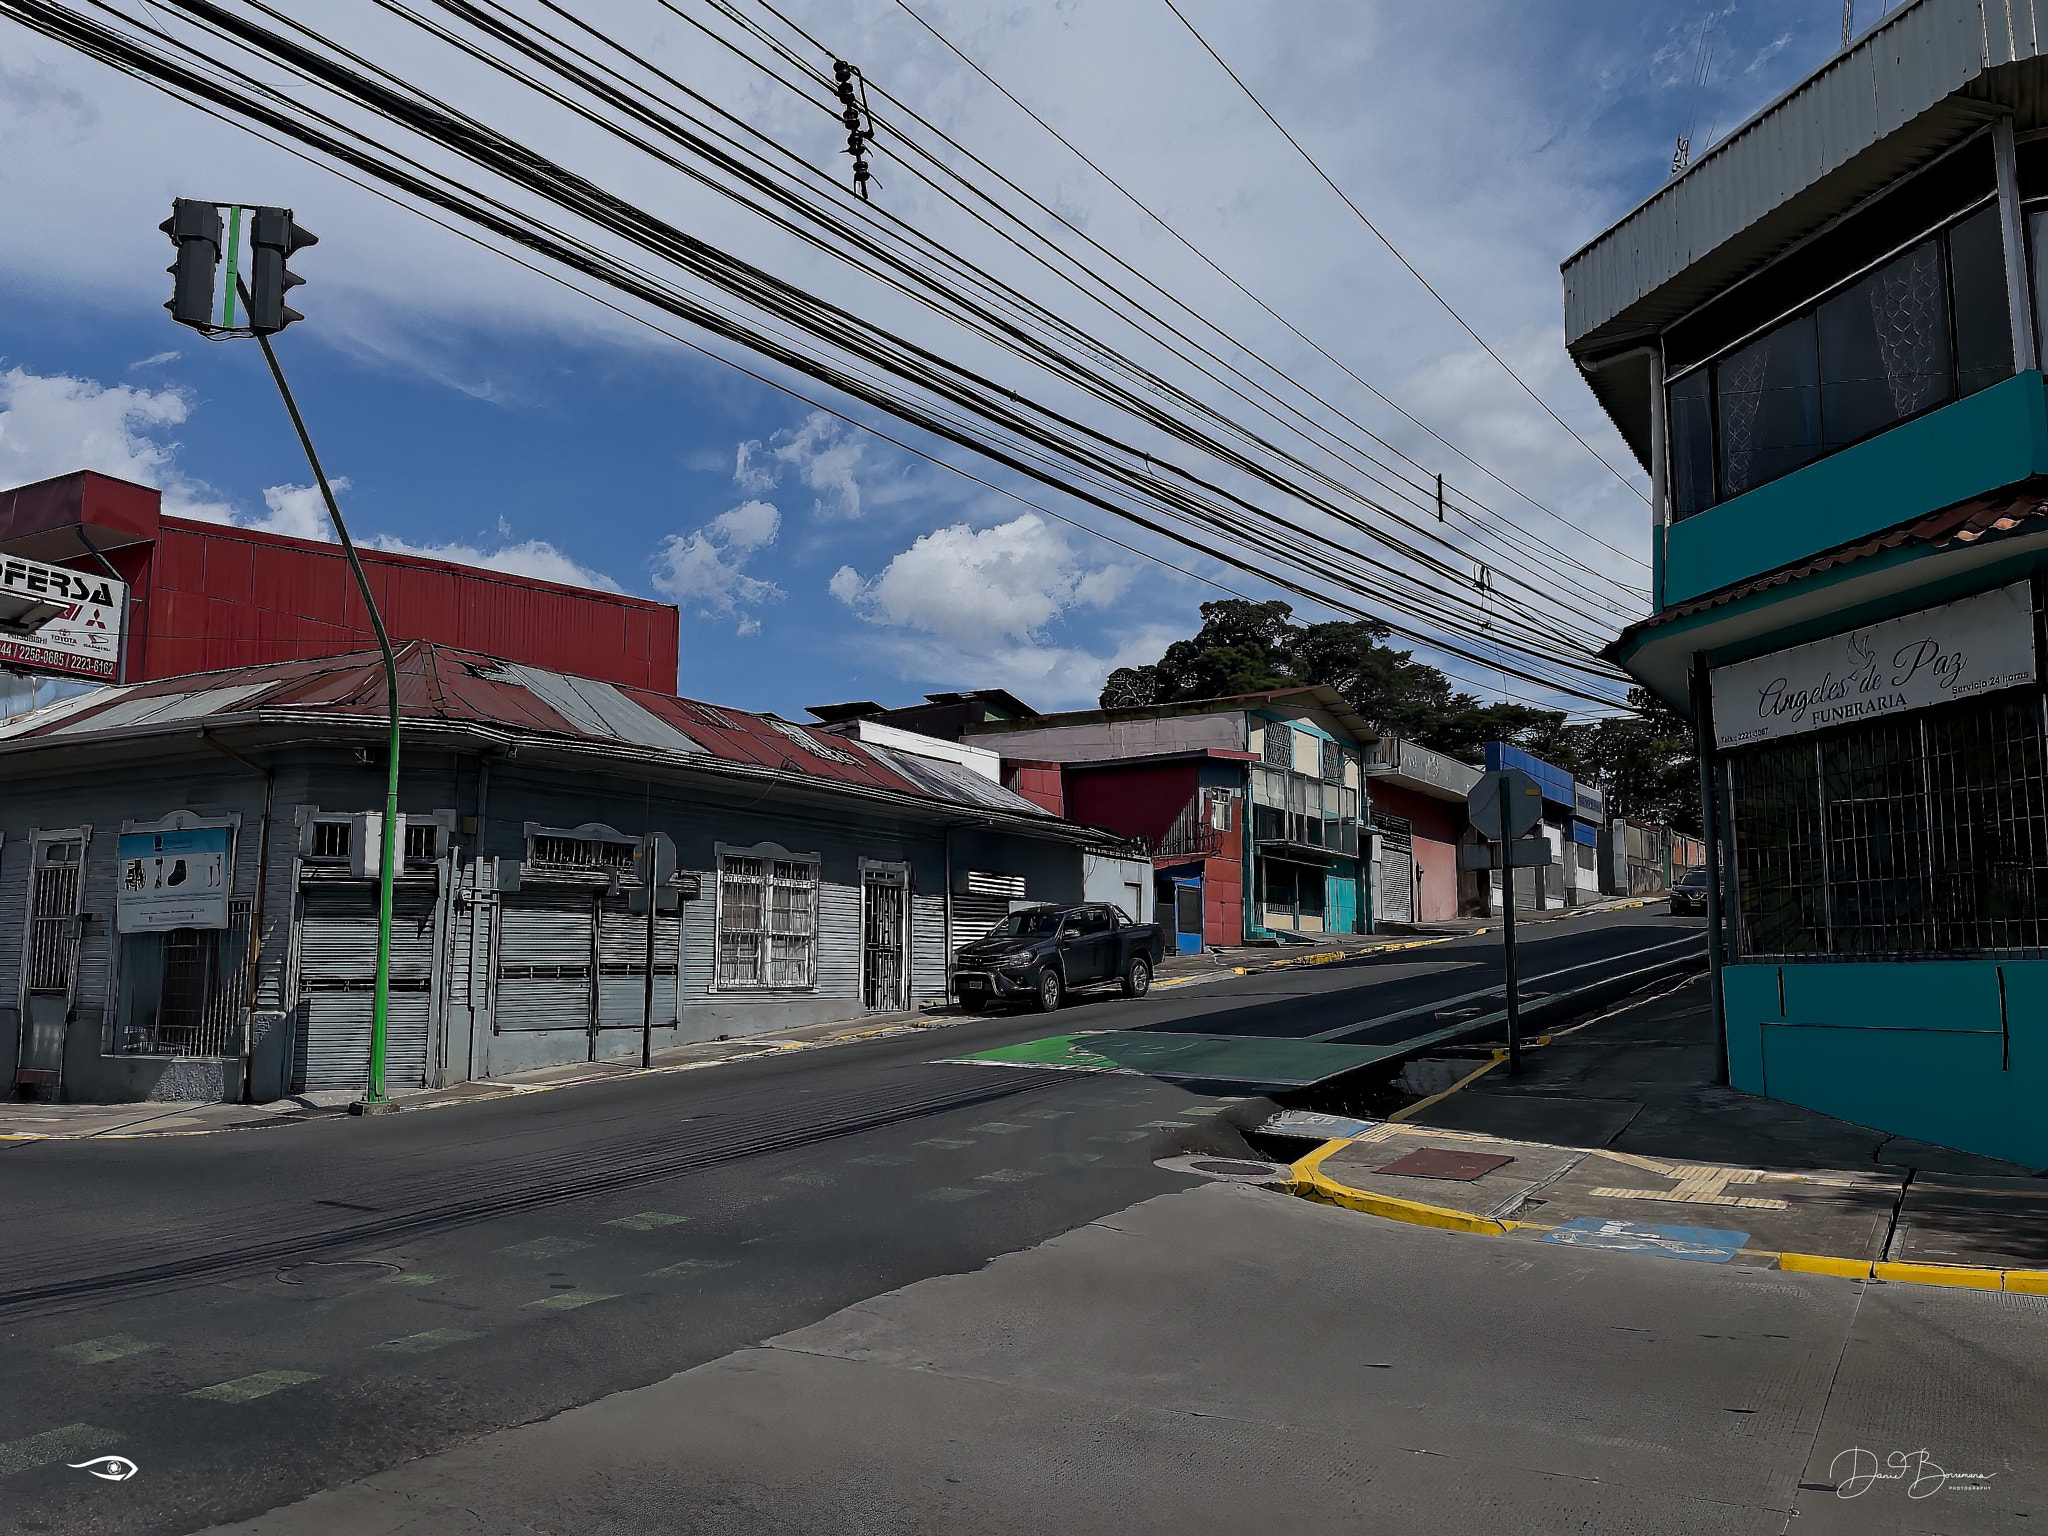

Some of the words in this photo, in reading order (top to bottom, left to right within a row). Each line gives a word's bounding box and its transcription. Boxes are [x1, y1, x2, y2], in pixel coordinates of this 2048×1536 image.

[0, 560, 114, 607] FERSA
[51, 634, 77, 644] TOYOTA
[1859, 664, 1882, 693] de
[1892, 638, 1968, 689] Paz
[1952, 680, 1987, 694] Servicio
[1989, 675, 2000, 686] 24
[2002, 672, 2029, 684] horas
[1812, 692, 1908, 725] FUNERARIA
